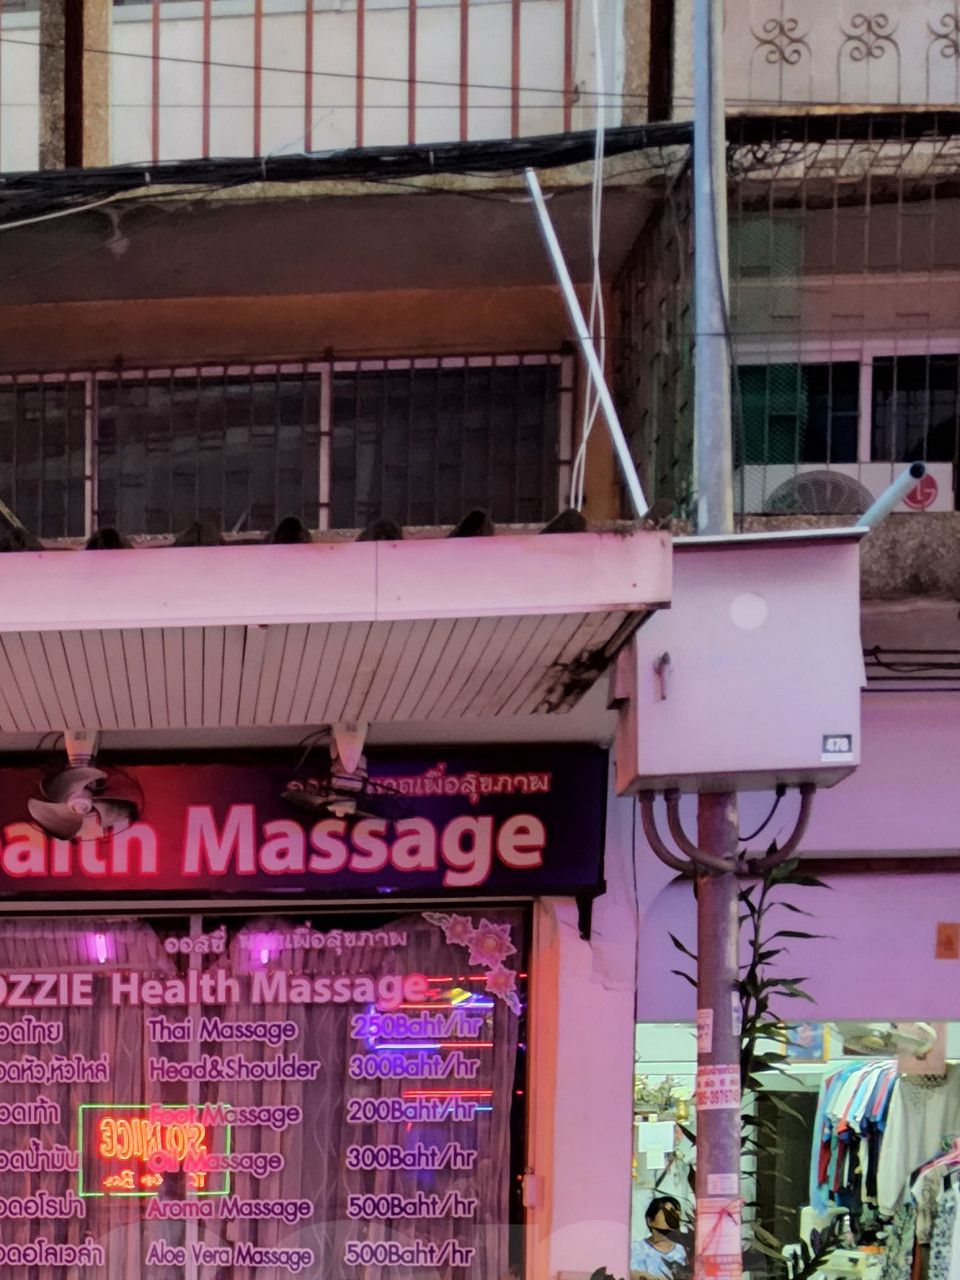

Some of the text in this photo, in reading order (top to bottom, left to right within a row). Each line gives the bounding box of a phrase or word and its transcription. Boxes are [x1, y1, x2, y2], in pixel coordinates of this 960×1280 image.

[182, 804, 547, 886] Massage
[111, 970, 241, 1005] Health
[252, 970, 427, 1011] Massage
[147, 1017, 299, 1046] Thai Massage
[149, 1055, 320, 1081] Head&Shoulder
[349, 1052, 480, 1079] 300Baht/hr
[149, 1102, 303, 1131] Foot Massage
[347, 1097, 476, 1122] 200Baht/hr
[147, 1151, 284, 1178] Oil Massage
[346, 1143, 477, 1169] 300Baht/hr
[146, 1195, 313, 1224] Aroma Massage
[347, 1191, 477, 1218] 500Baht/hr
[146, 1239, 314, 1273] Aloe Vera Massage
[344, 1240, 476, 1266] 500Baht/hr
